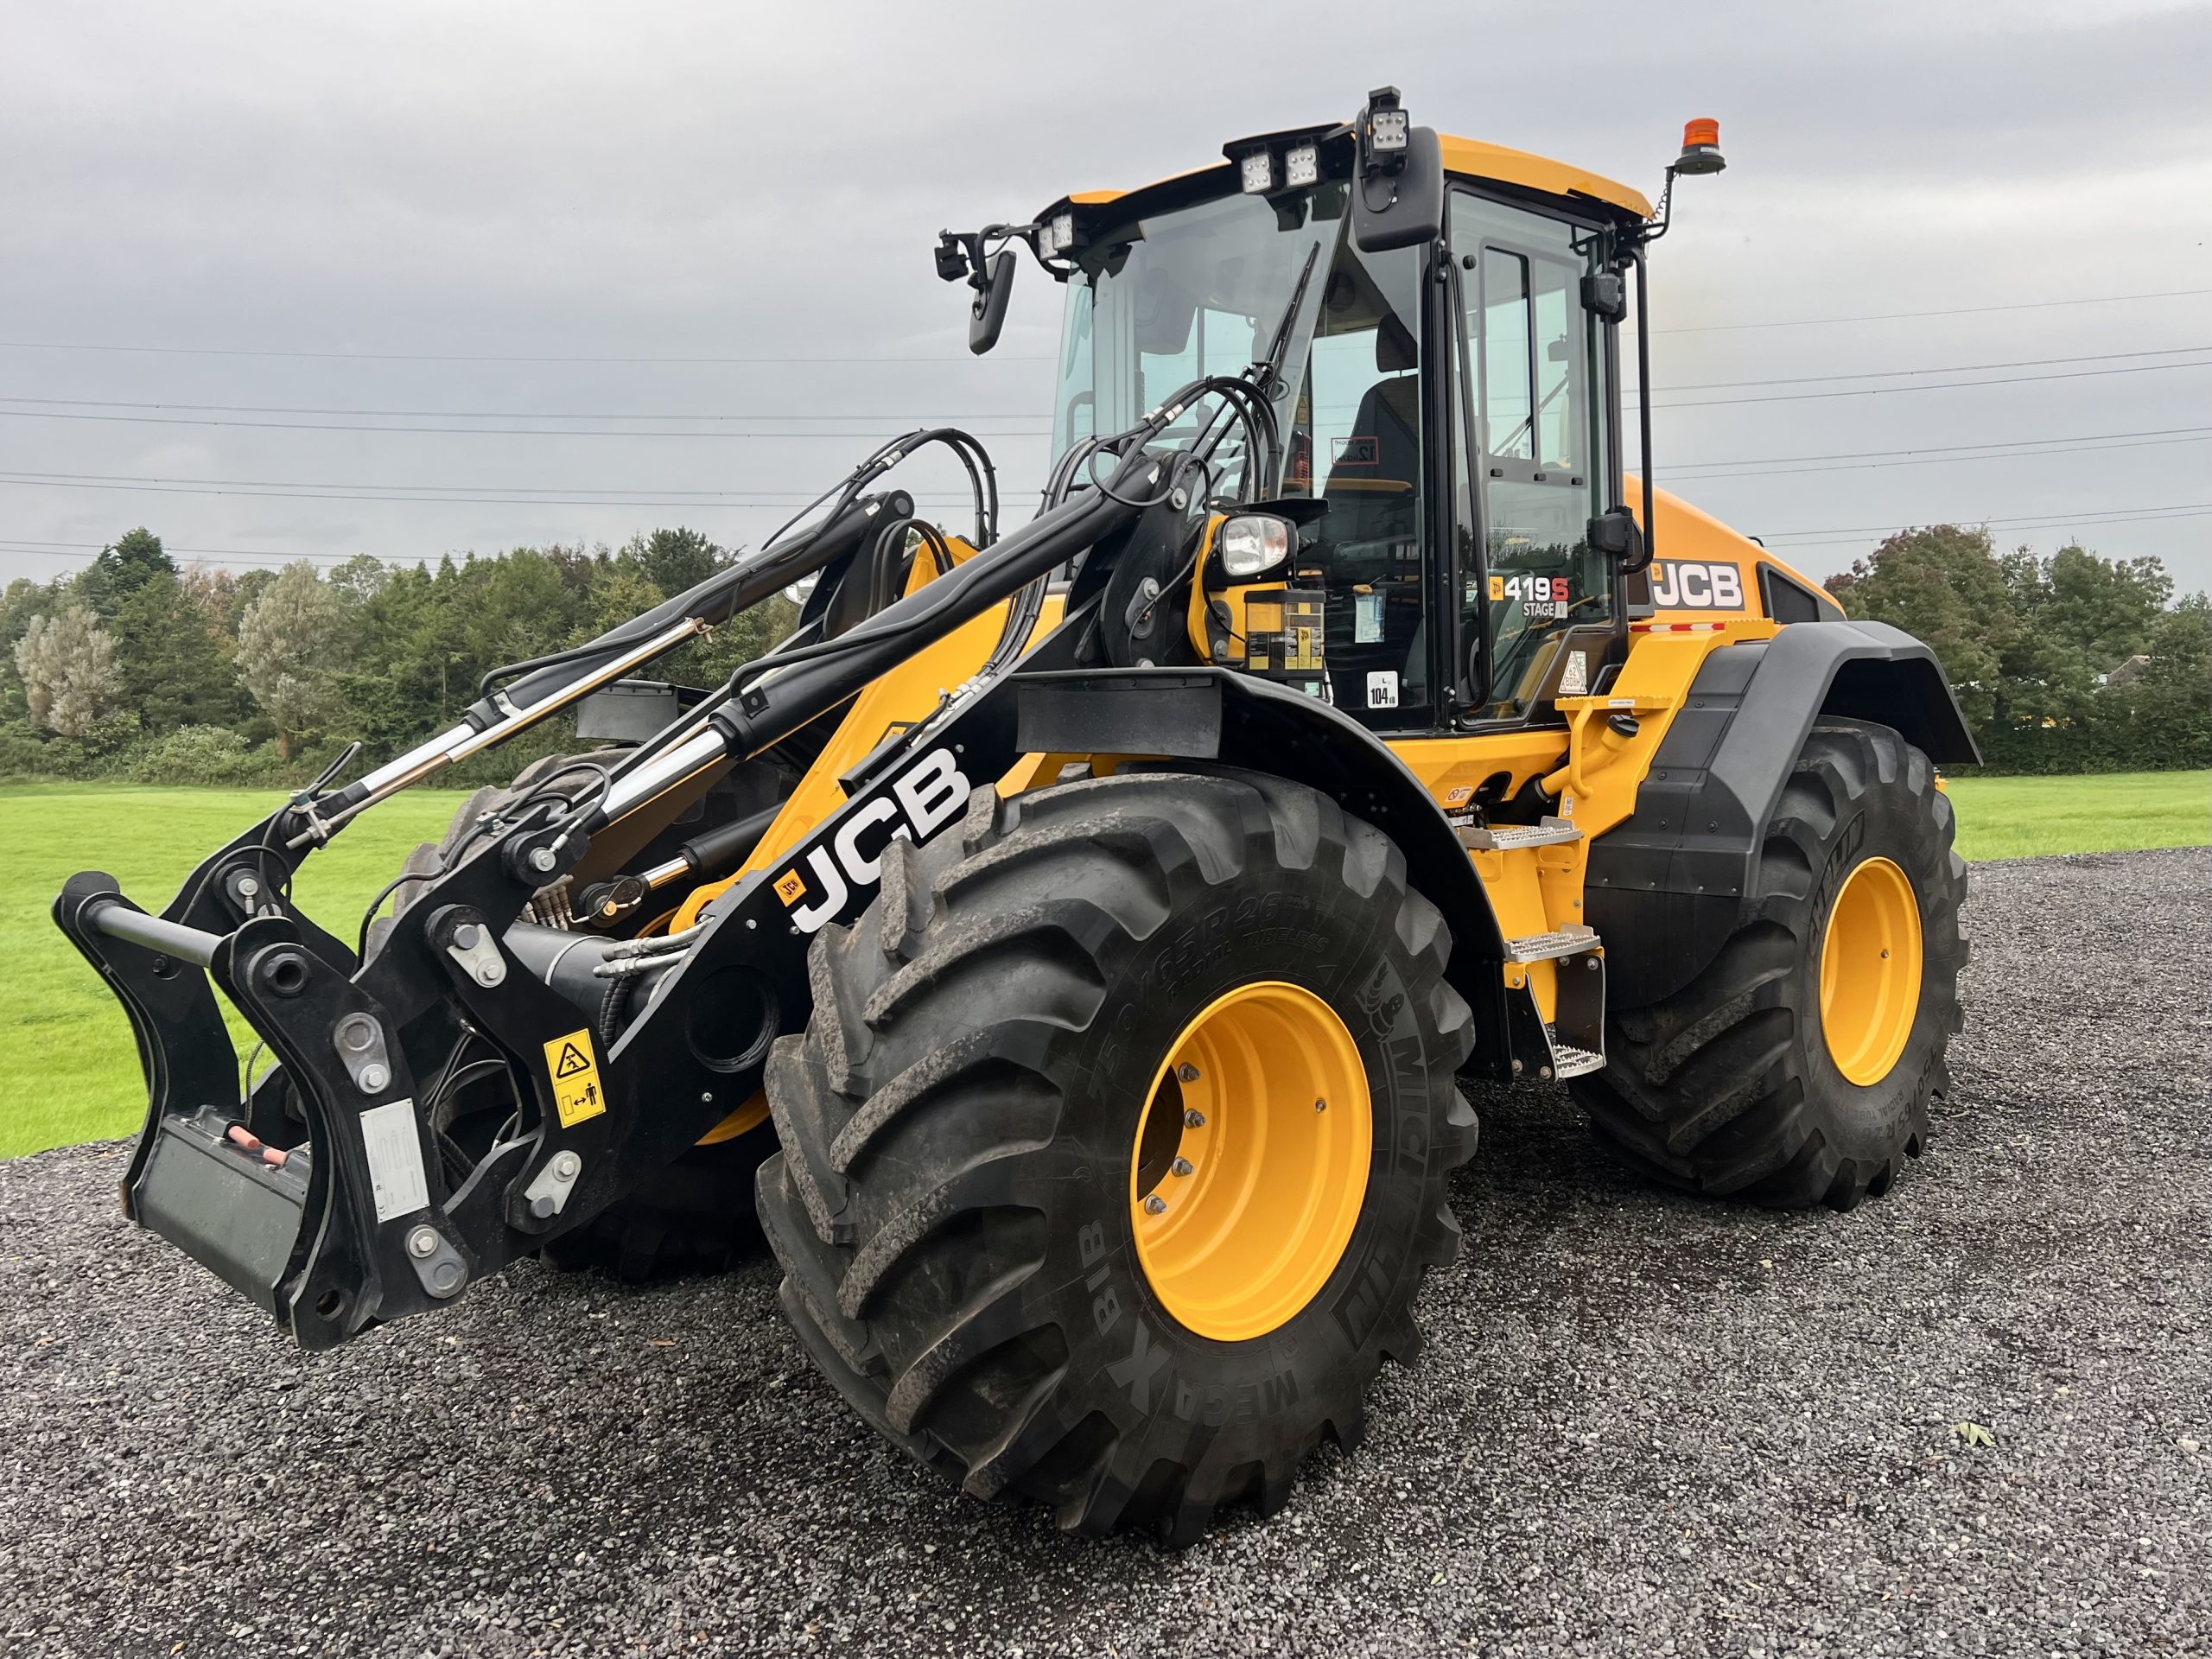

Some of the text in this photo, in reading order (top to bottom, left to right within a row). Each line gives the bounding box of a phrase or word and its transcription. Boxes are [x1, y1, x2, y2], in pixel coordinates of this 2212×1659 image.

[1504, 576, 1569, 601] 419S
[1653, 563, 1743, 607] JCB
[1523, 602, 1554, 617] STAGE
[1370, 688, 1389, 705] 104
[791, 747, 971, 933] JCB
[782, 880, 798, 895] JCB
[1240, 926, 1330, 954] TUBELESS
